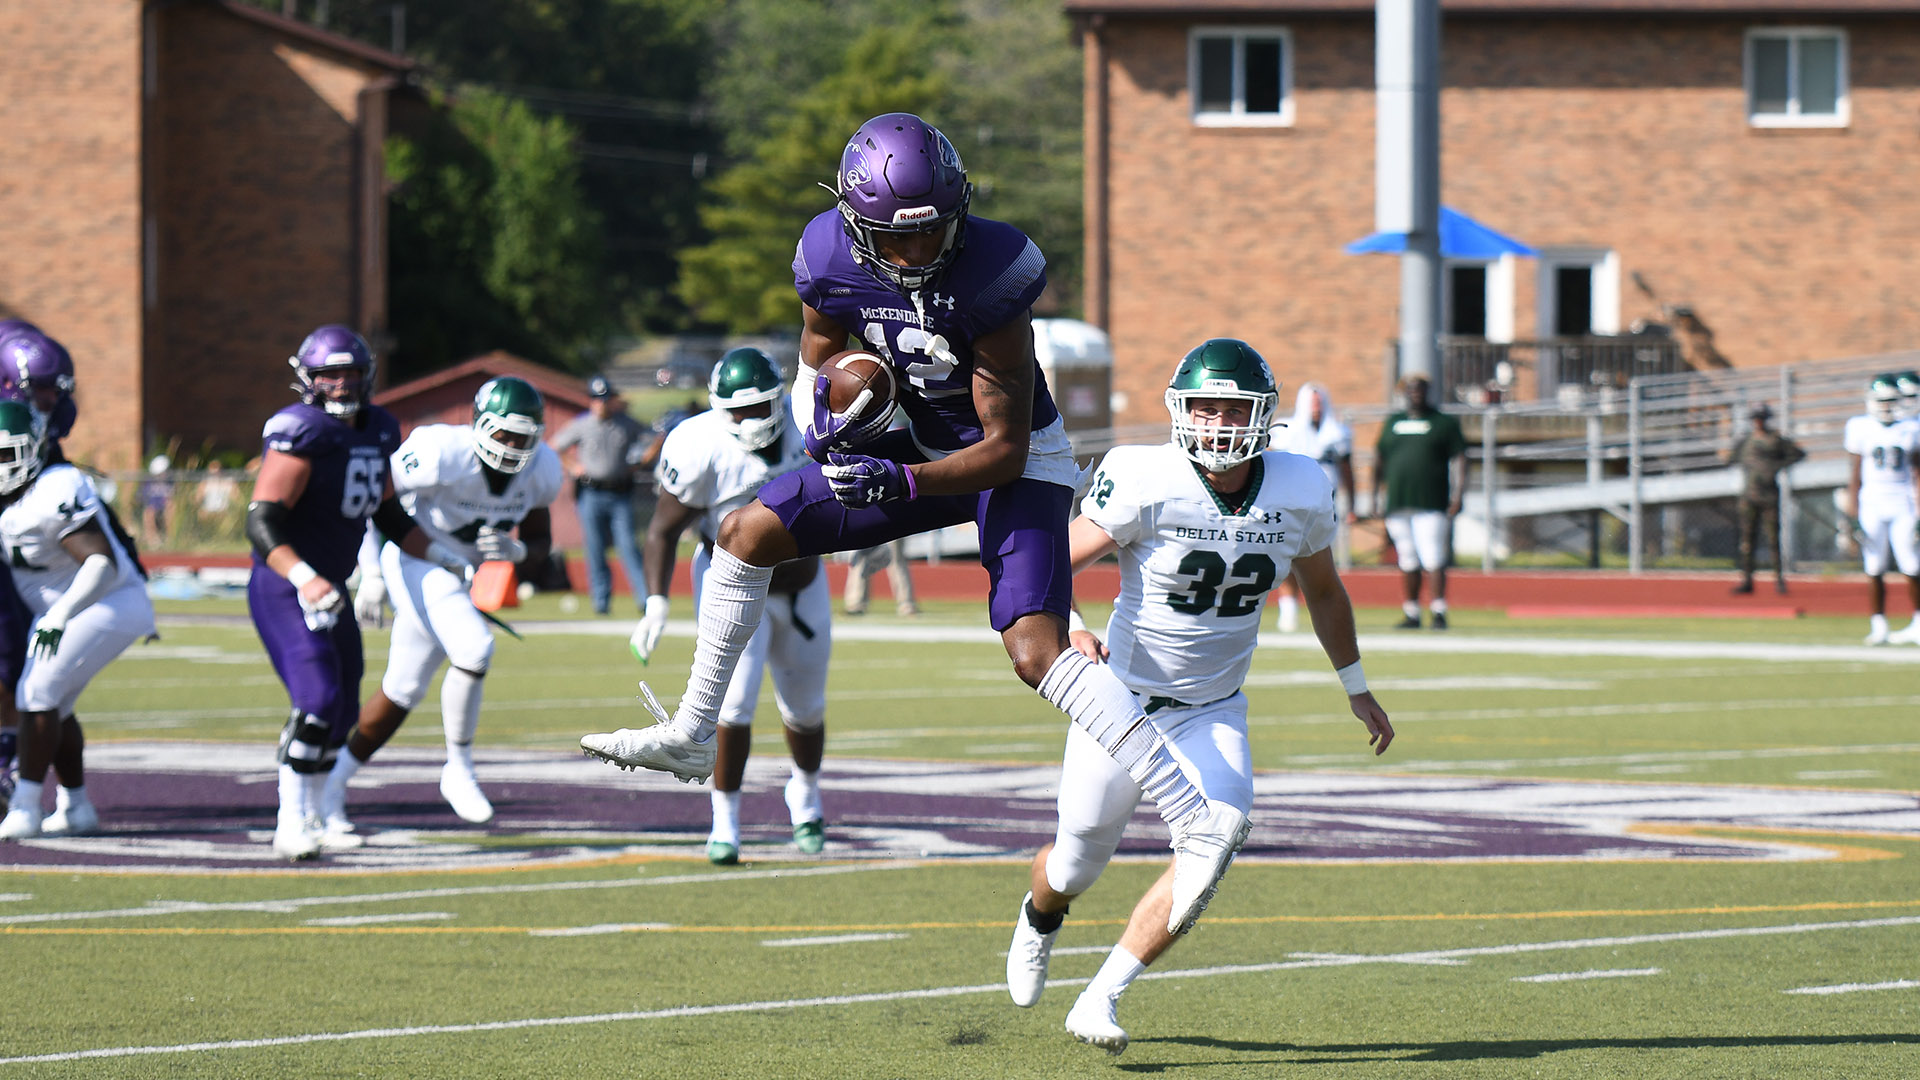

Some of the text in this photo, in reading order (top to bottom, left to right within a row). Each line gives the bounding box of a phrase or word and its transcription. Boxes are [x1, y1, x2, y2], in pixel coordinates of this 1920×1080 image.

[899, 208, 934, 221] Riddell
[340, 457, 386, 519] 65
[1175, 526, 1286, 544] DELTA STATE
[1166, 549, 1277, 618] 32
